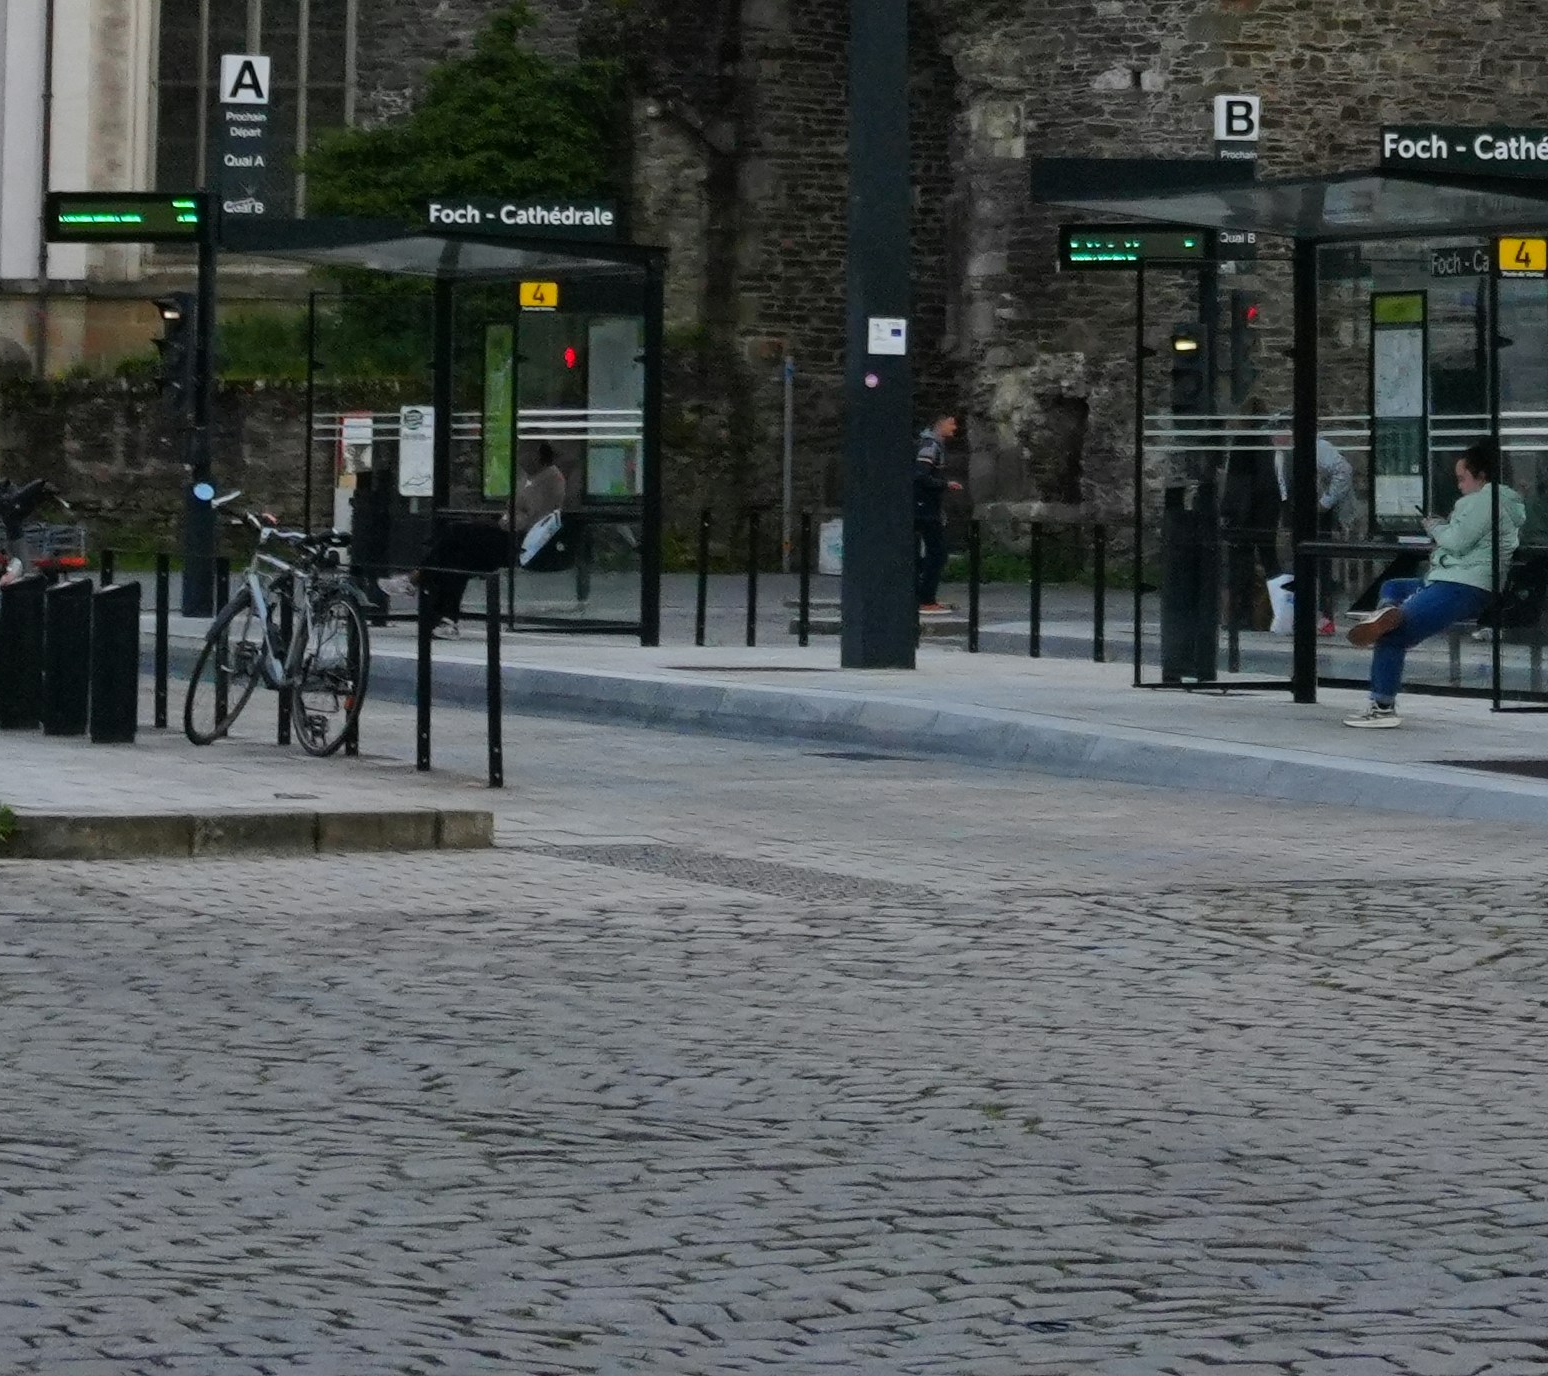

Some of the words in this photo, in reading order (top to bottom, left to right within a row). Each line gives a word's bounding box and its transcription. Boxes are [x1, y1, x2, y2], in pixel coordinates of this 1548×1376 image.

[229, 60, 265, 99] A
[225, 111, 267, 122] Prochain
[1226, 100, 1255, 137] B
[229, 126, 262, 138] Départ
[1220, 150, 1258, 160] Prochain
[1384, 133, 1448, 160] Foch
[224, 154, 252, 167] Quai
[254, 156, 265, 167] A
[428, 203, 481, 224] Foch
[500, 204, 614, 226] Cathédrale
[1219, 232, 1245, 245] Quai
[1247, 233, 1256, 244] B
[1514, 241, 1532, 268] 4
[532, 285, 545, 305] 4
